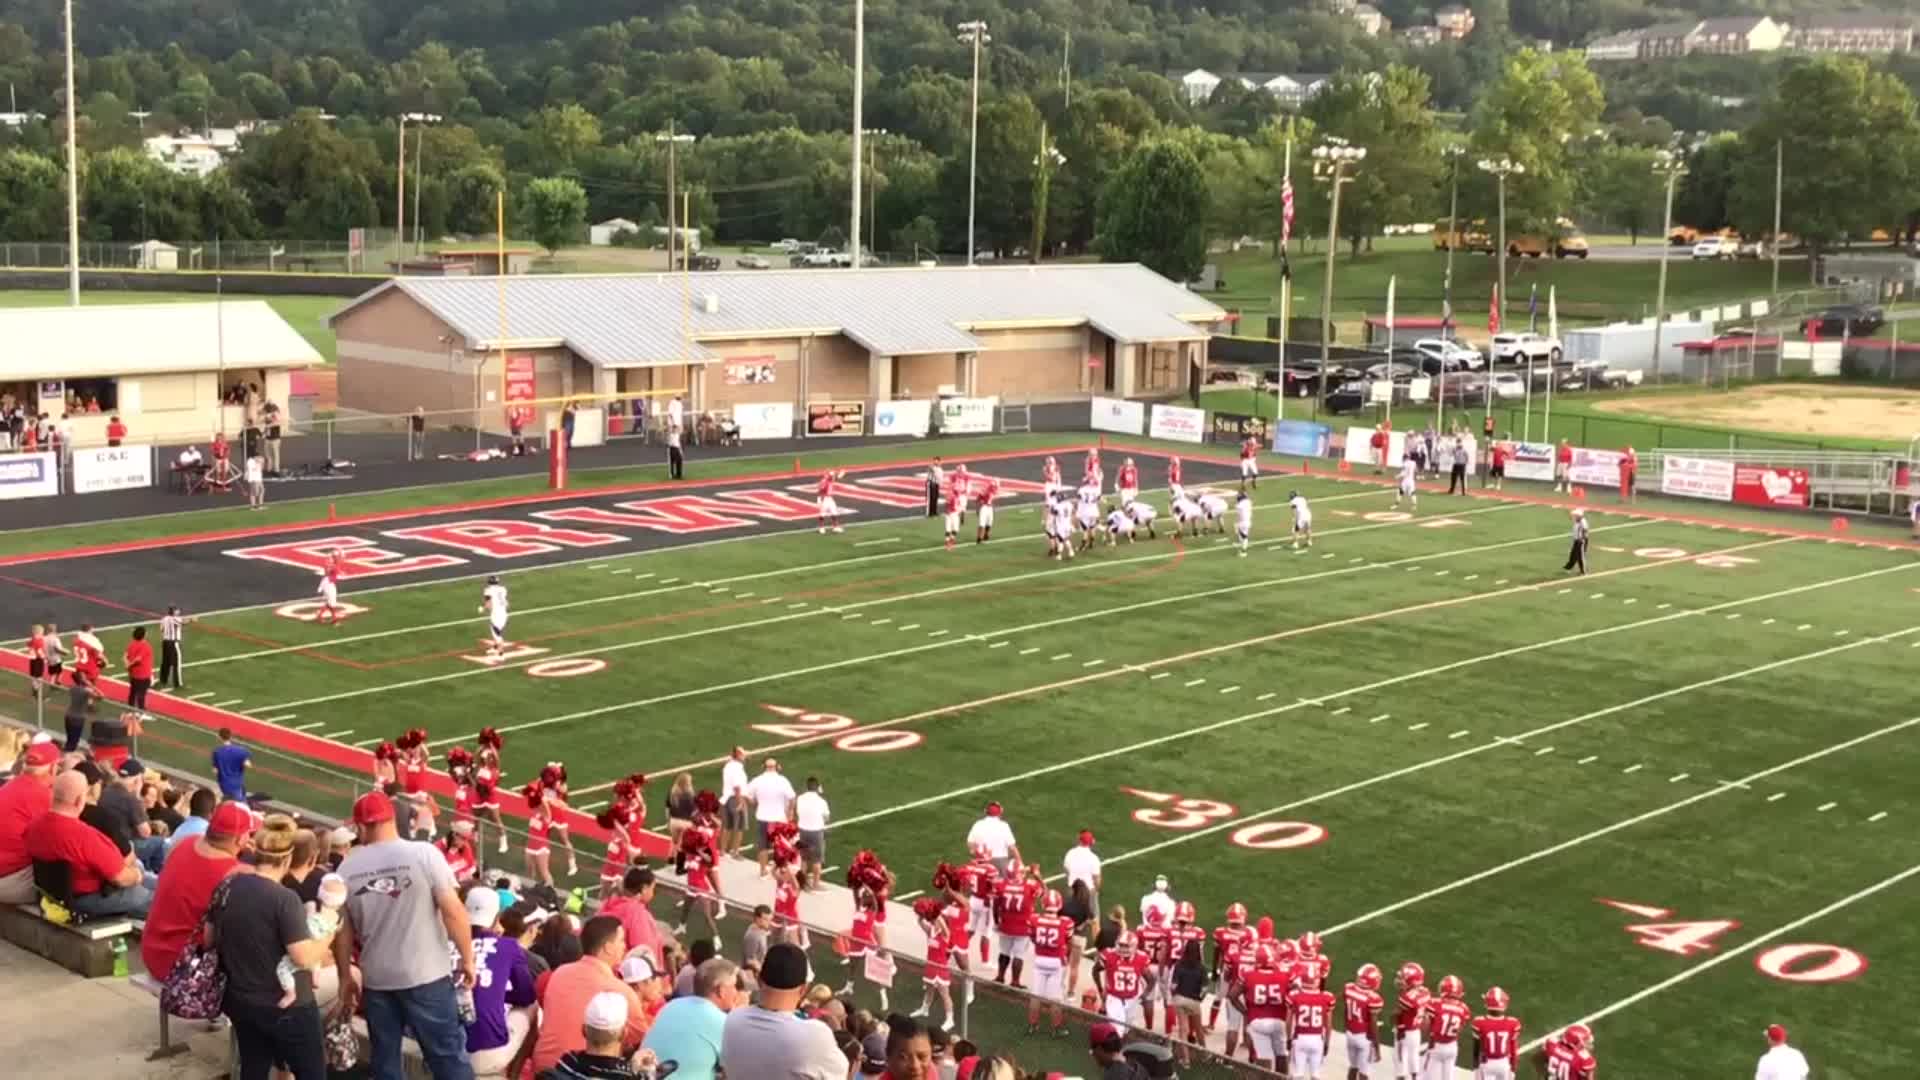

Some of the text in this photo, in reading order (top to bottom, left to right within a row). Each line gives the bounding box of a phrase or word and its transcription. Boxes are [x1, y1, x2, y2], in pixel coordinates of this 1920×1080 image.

[221, 470, 1078, 580] ERWIN
[748, 712, 926, 752] 20
[1130, 797, 1329, 850] 30
[1003, 892, 1025, 913] 77
[1035, 926, 1059, 946] 62
[1624, 918, 1867, 982] 40
[1113, 971, 1138, 991] 63
[1253, 984, 1282, 1005] 65
[1297, 1004, 1323, 1028] 26
[1346, 1000, 1362, 1023] 14
[1440, 1013, 1461, 1037] 12
[1486, 1031, 1509, 1055] 17
